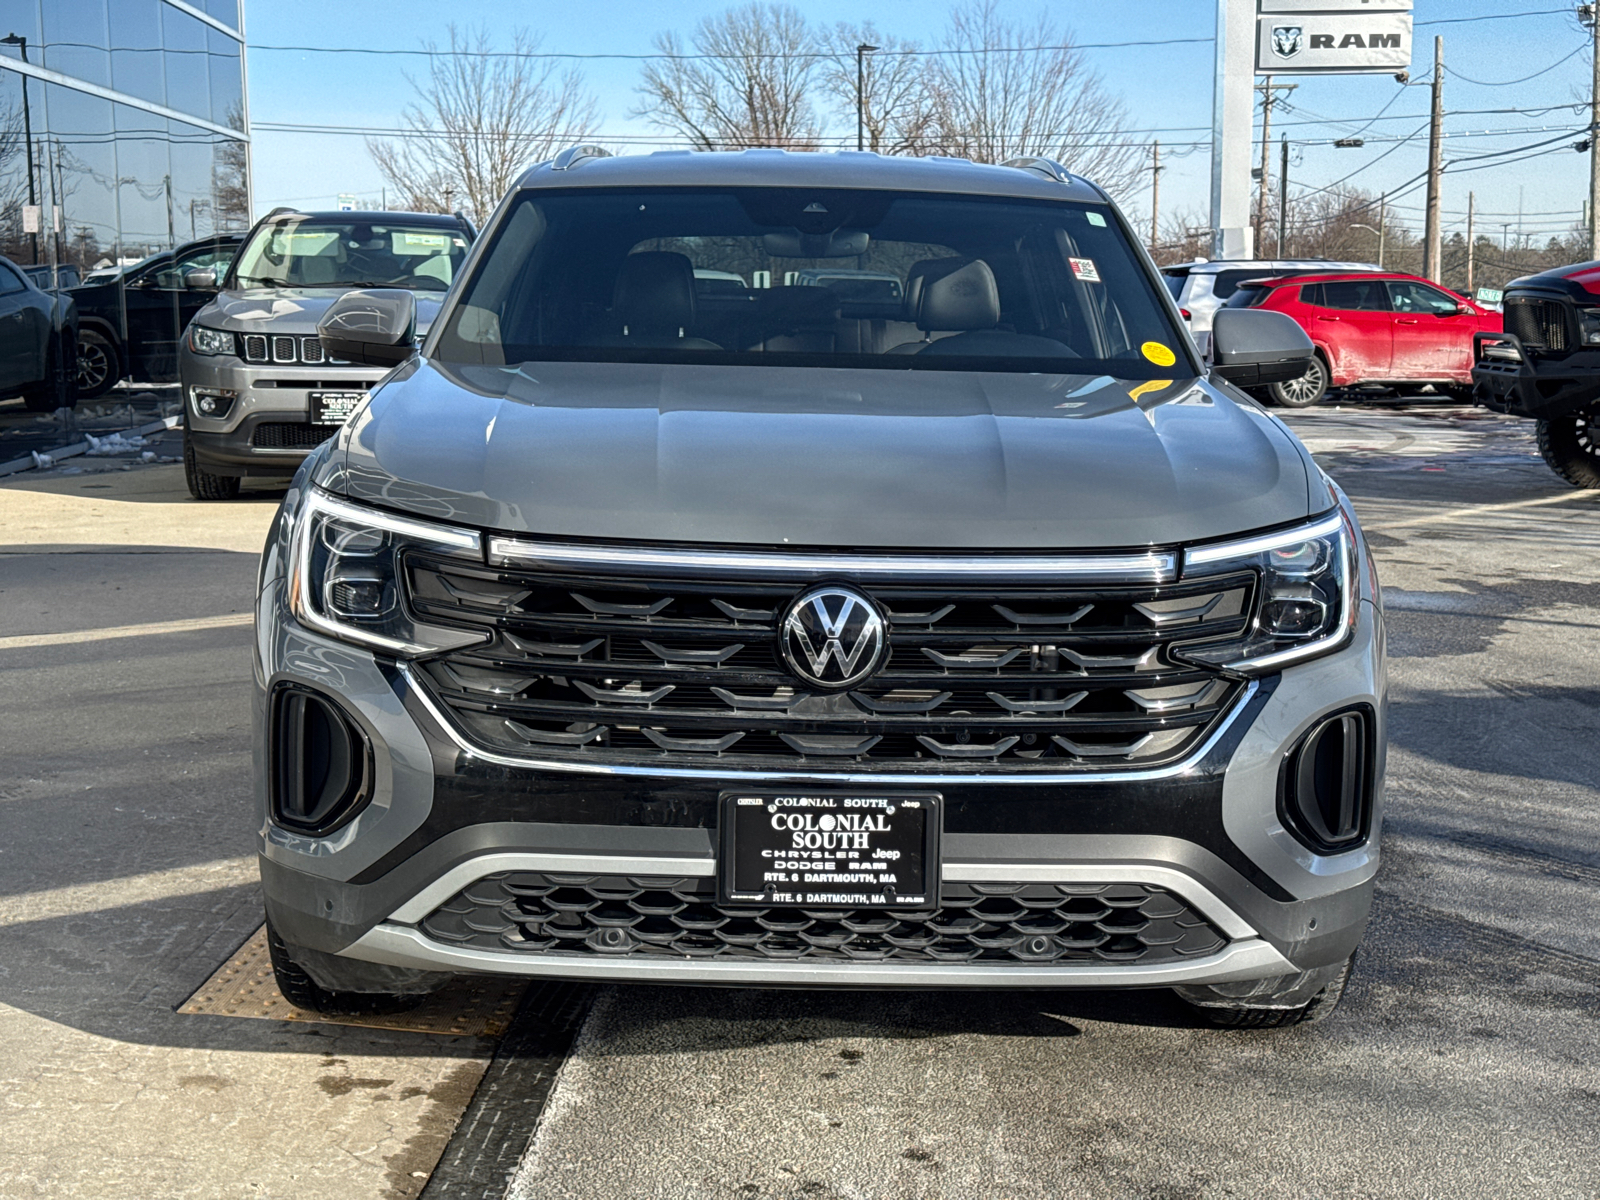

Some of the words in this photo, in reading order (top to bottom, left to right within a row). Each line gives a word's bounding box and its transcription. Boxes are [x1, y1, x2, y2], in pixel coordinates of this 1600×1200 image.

[1309, 33, 1402, 49] RAM
[774, 797, 837, 808] COLONIAL
[843, 798, 888, 808] SOUTH
[900, 800, 921, 809] Jeep
[770, 813, 892, 832] COLONIAL
[792, 831, 871, 849] SOUTH
[761, 849, 860, 859] CHRYSLER
[871, 847, 901, 861] Jeep
[774, 860, 837, 870] DODGE
[848, 862, 888, 870] RAM
[763, 872, 790, 883] RTE.
[791, 872, 799, 882] 6
[804, 873, 878, 885] DARTMOUTH,
[879, 873, 898, 883] MA
[772, 893, 795, 903] RTE.
[796, 893, 803, 903] 6
[806, 893, 869, 905] DARTMOUTH,
[871, 894, 887, 904] MA
